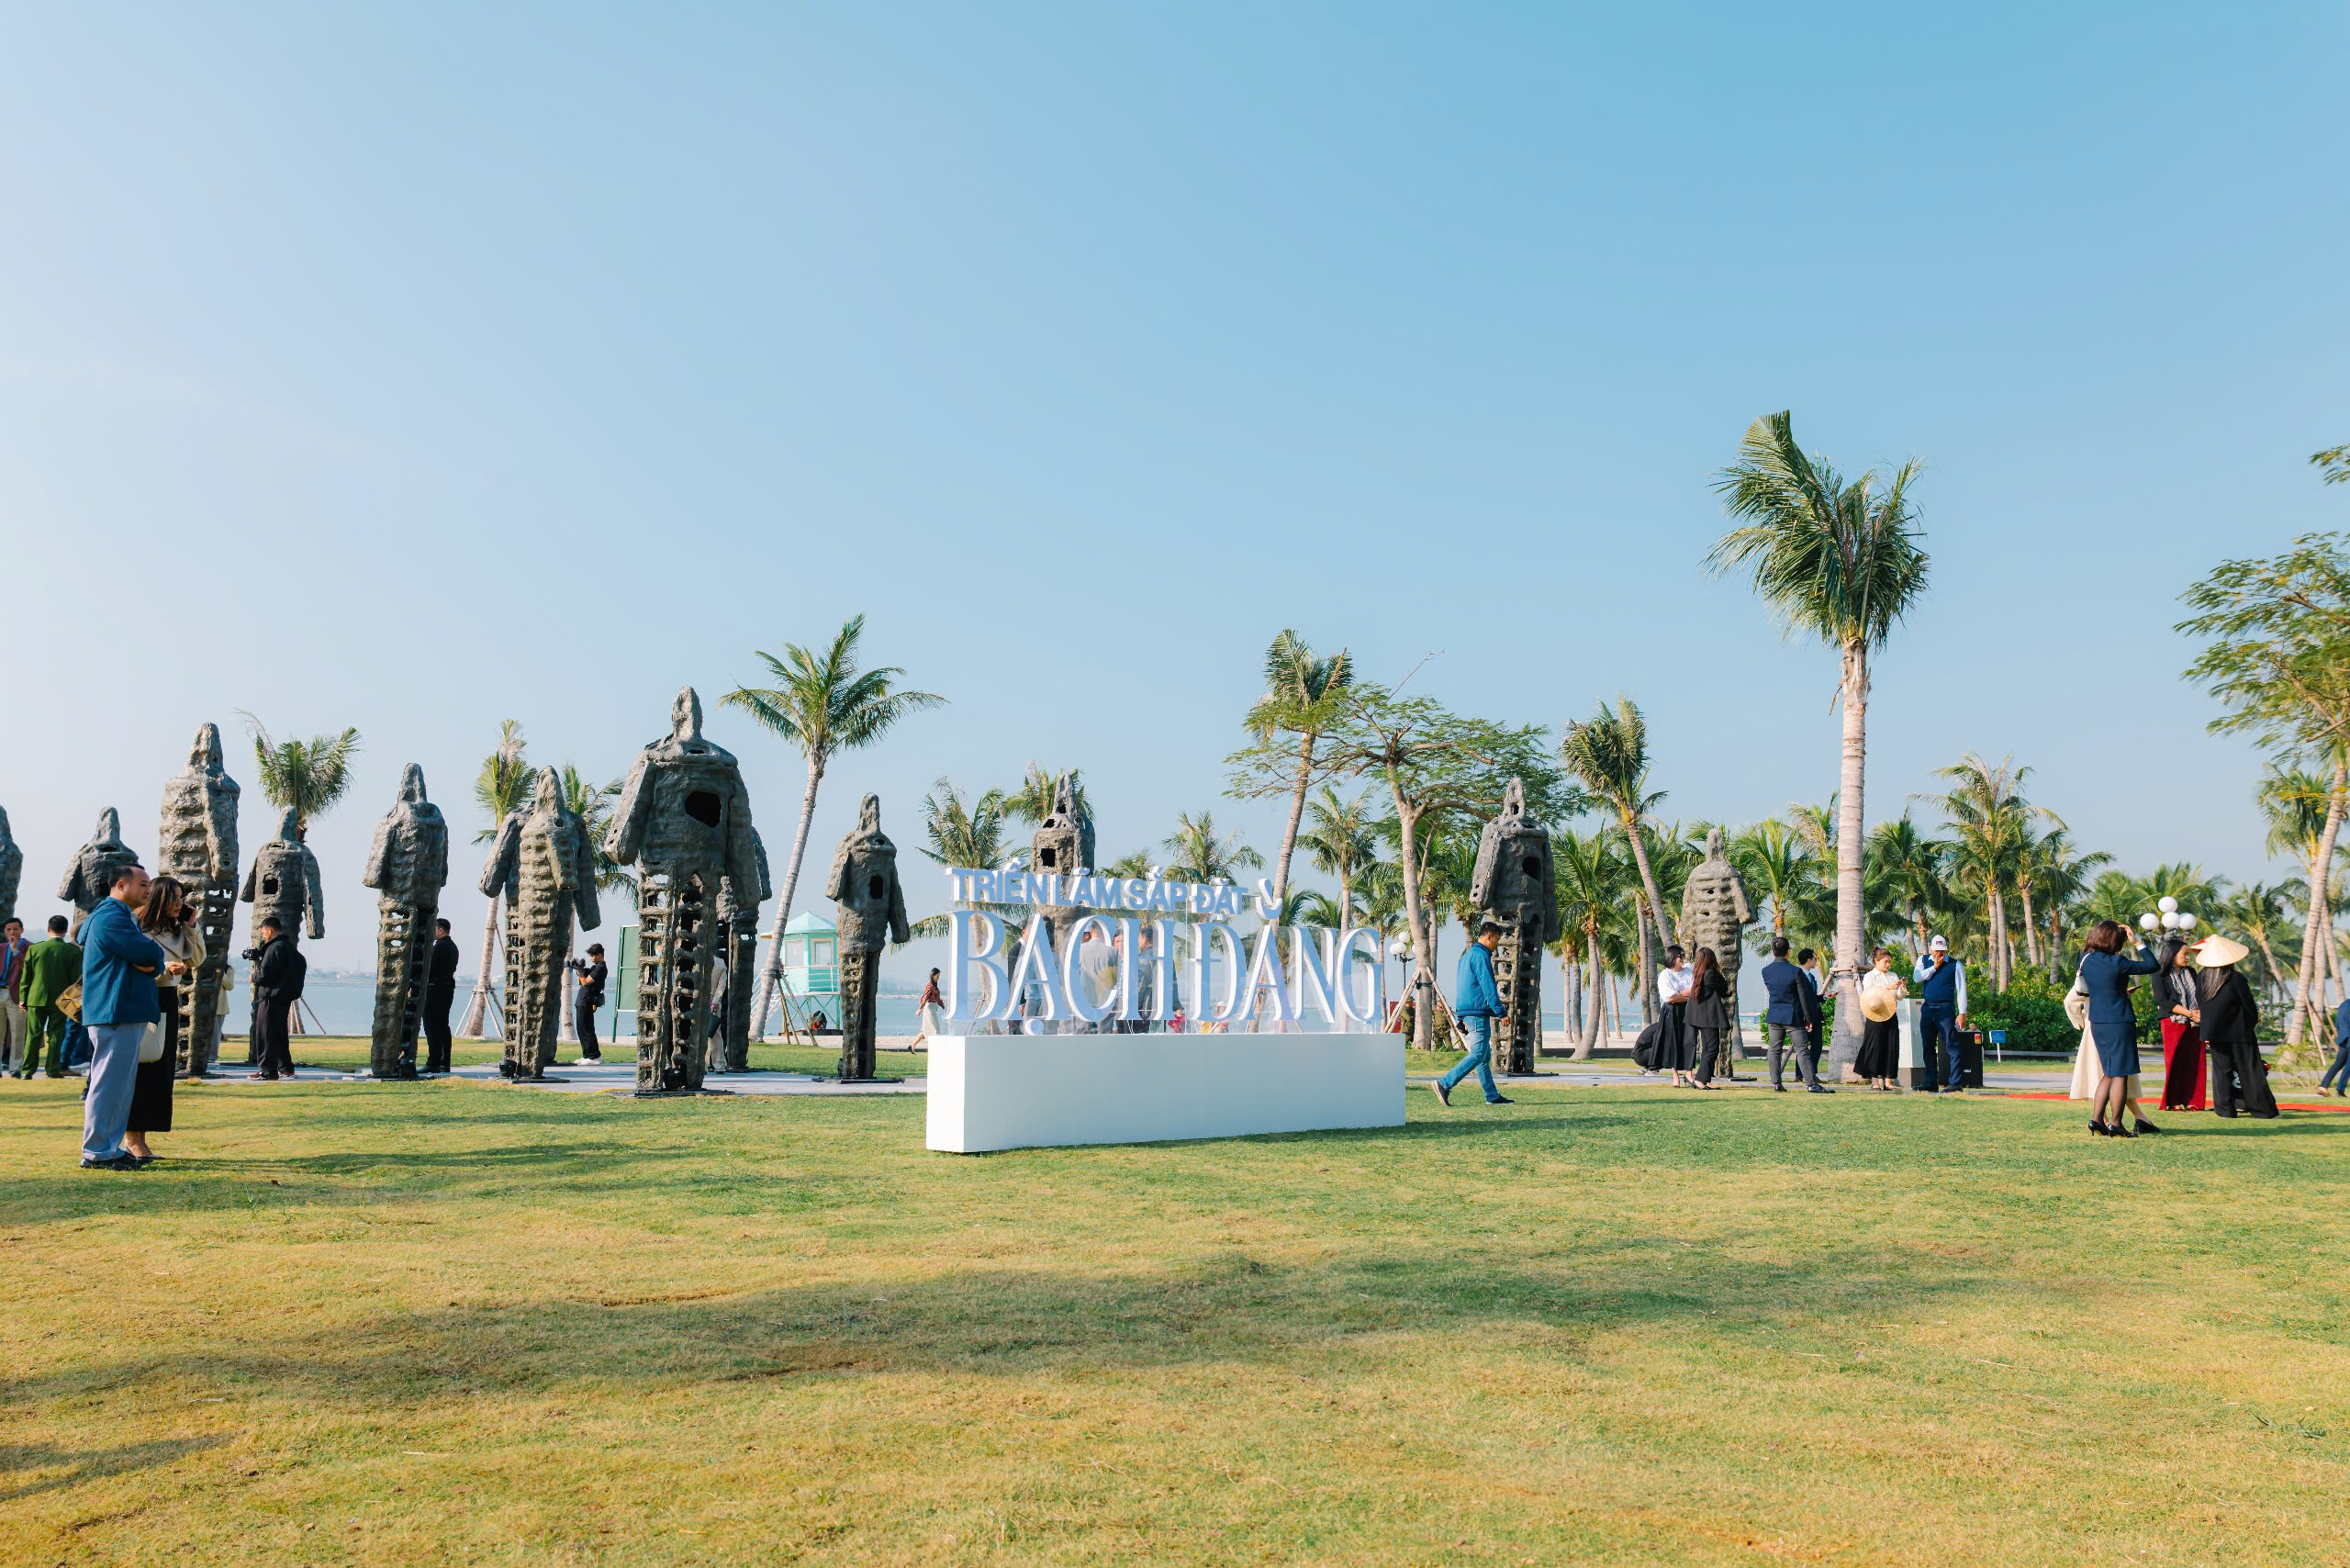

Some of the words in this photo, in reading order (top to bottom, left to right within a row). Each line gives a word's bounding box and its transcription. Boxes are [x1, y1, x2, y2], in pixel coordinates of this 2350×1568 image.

[1050, 868, 1120, 909] LÃM
[1190, 878, 1248, 921] ĐẶT
[943, 910, 1176, 1035] BẠCH
[1191, 879, 1384, 1024] ĐẰNG
